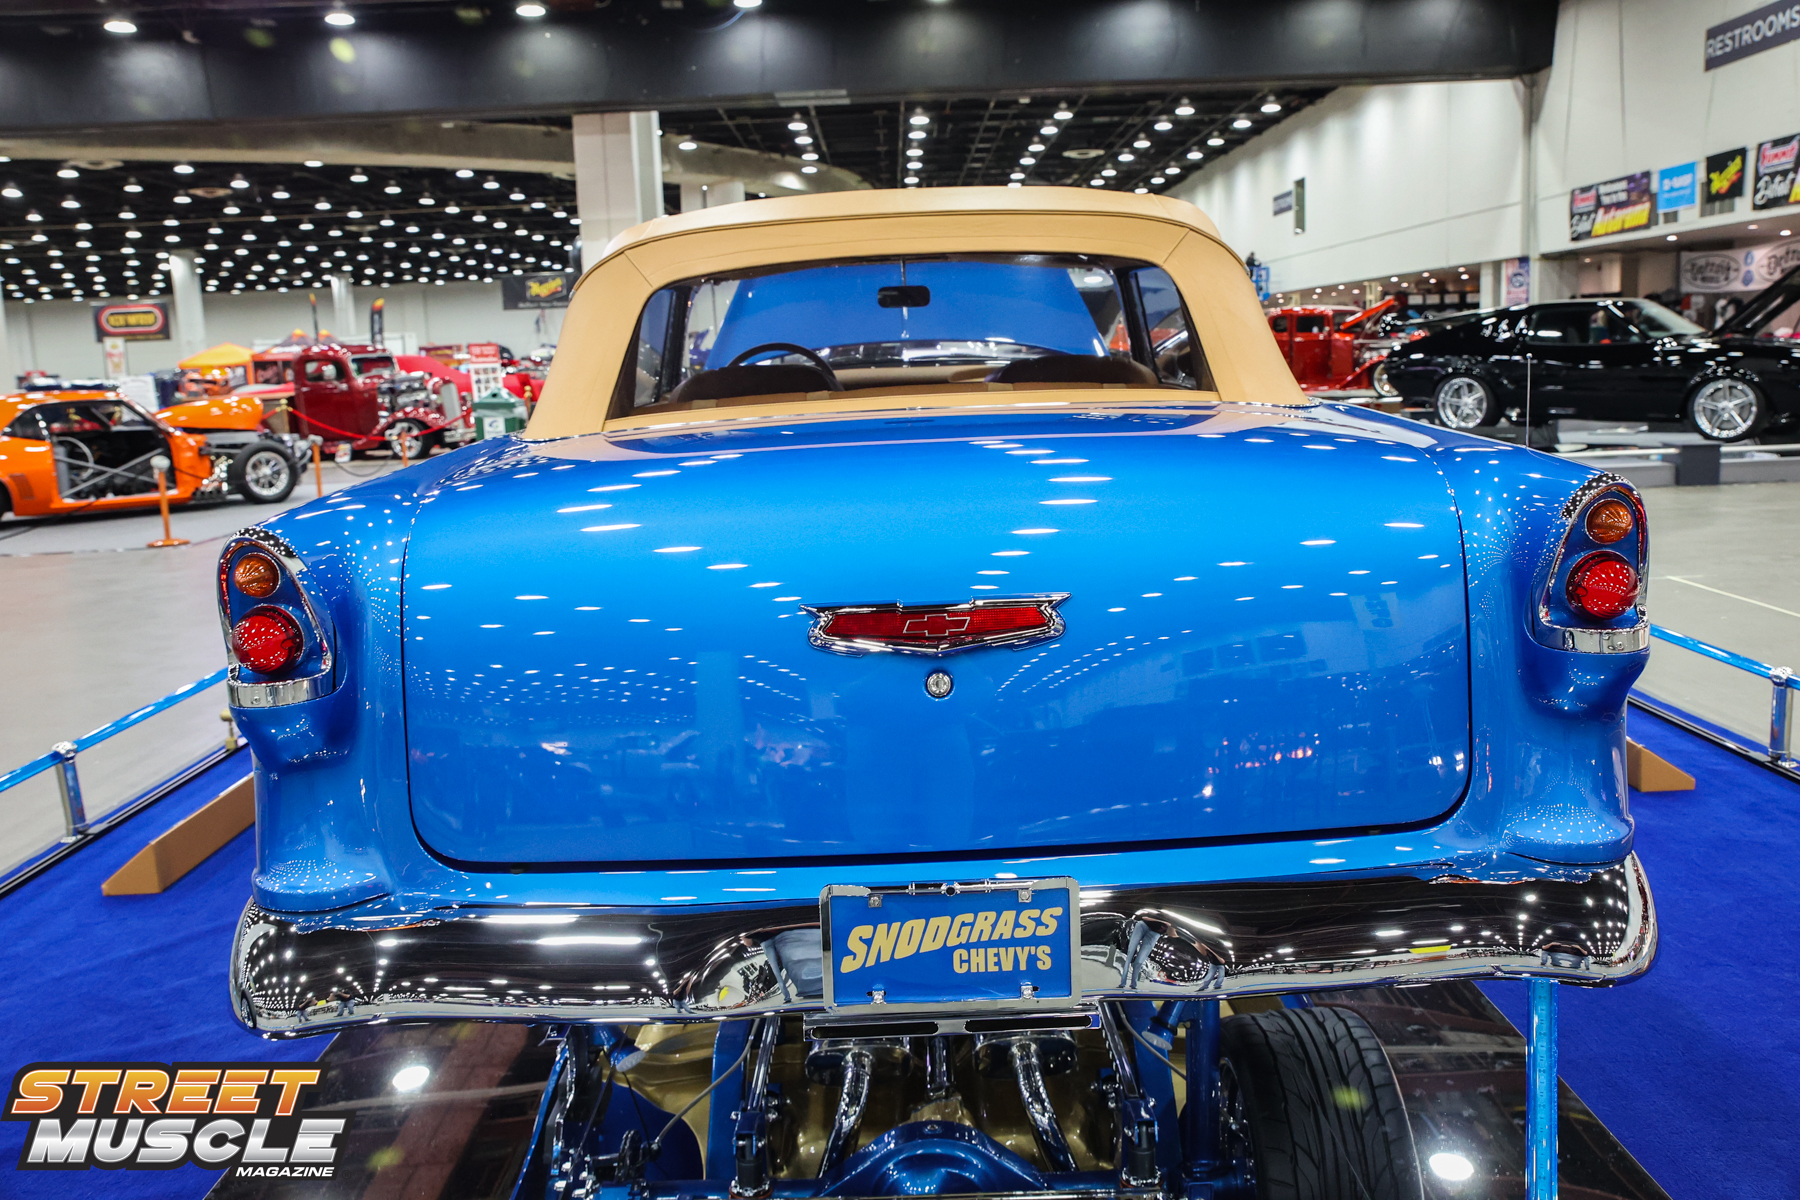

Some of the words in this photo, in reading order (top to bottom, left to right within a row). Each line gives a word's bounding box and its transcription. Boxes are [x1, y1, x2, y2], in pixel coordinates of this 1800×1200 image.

[1705, 4, 1800, 59] RESTROOMS
[840, 907, 1063, 973] SNODGRASS
[953, 945, 1052, 974] CHEVY'S
